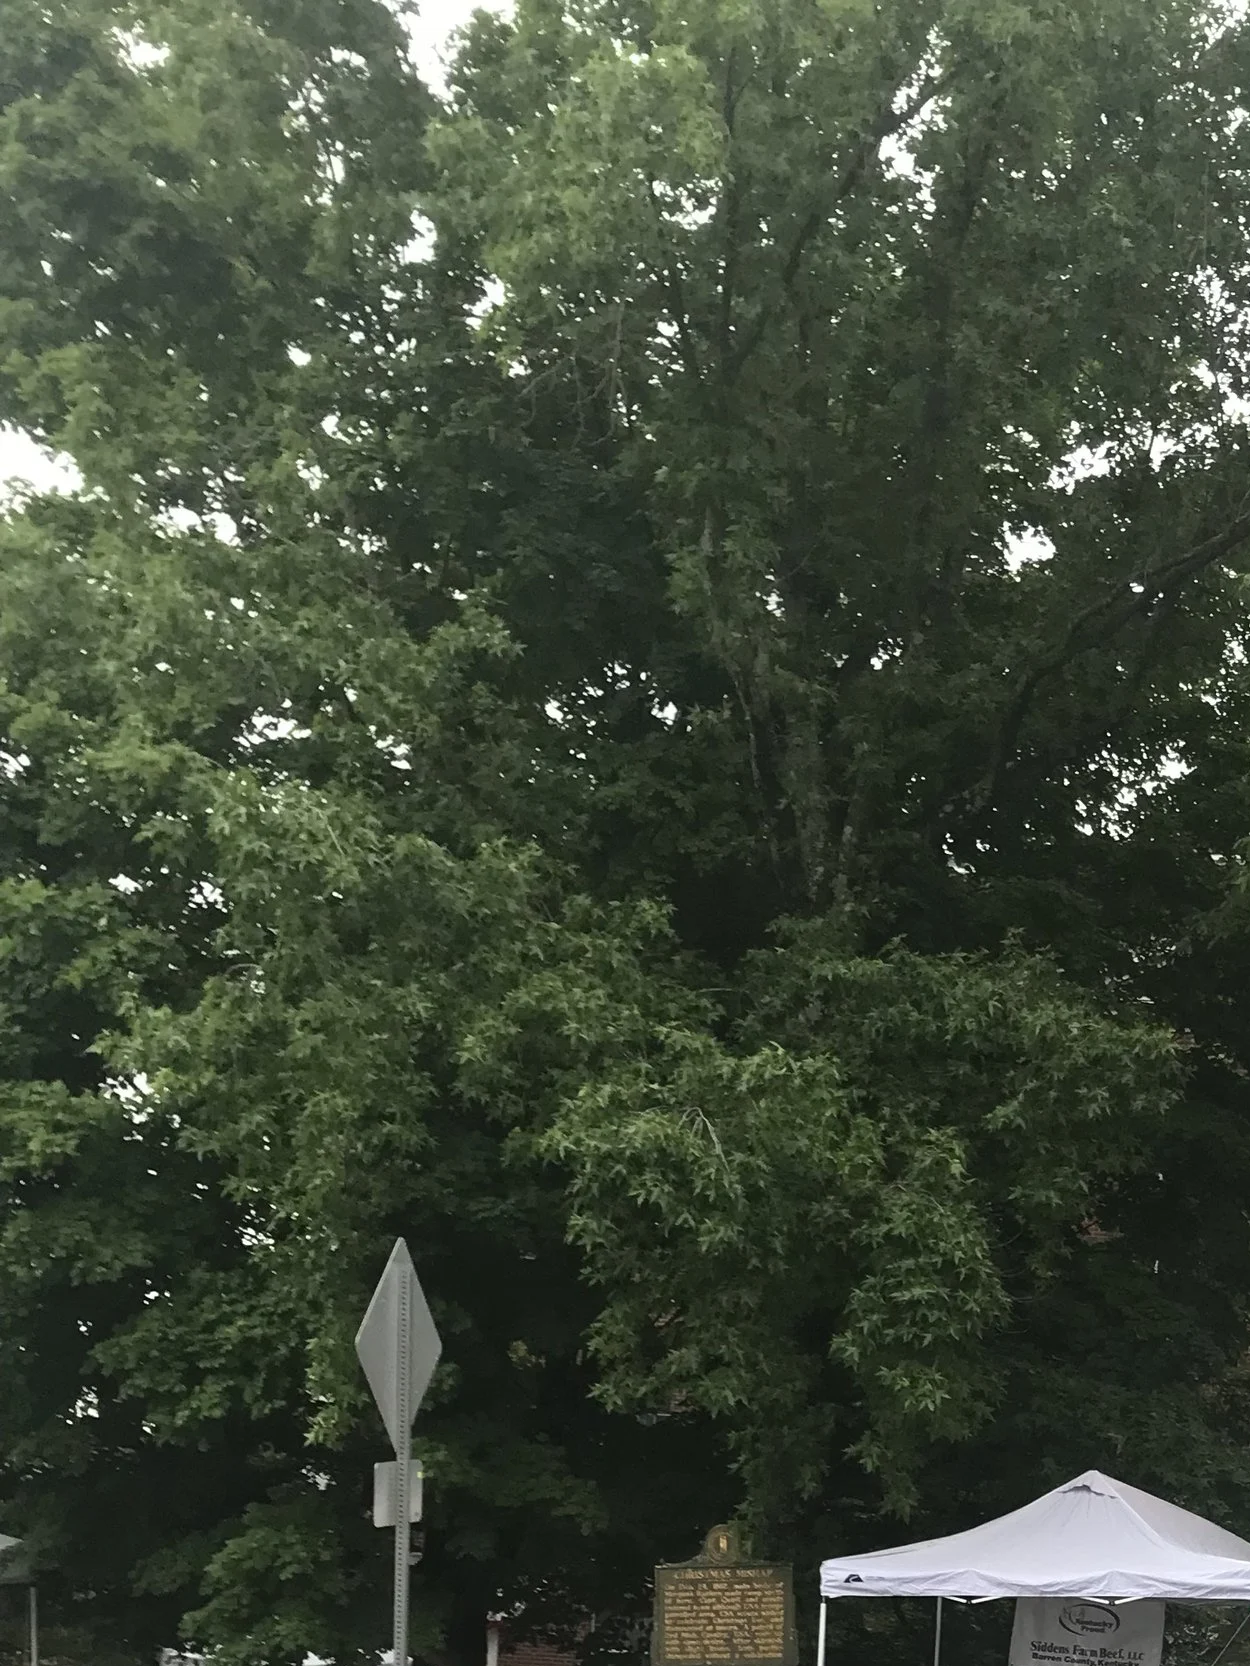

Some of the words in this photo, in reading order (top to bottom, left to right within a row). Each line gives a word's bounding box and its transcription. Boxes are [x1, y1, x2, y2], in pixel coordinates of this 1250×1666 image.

[1030, 1640, 1070, 1654] Siddens
[1073, 1644, 1098, 1658] Farm
[1032, 1652, 1062, 1662] Barren
